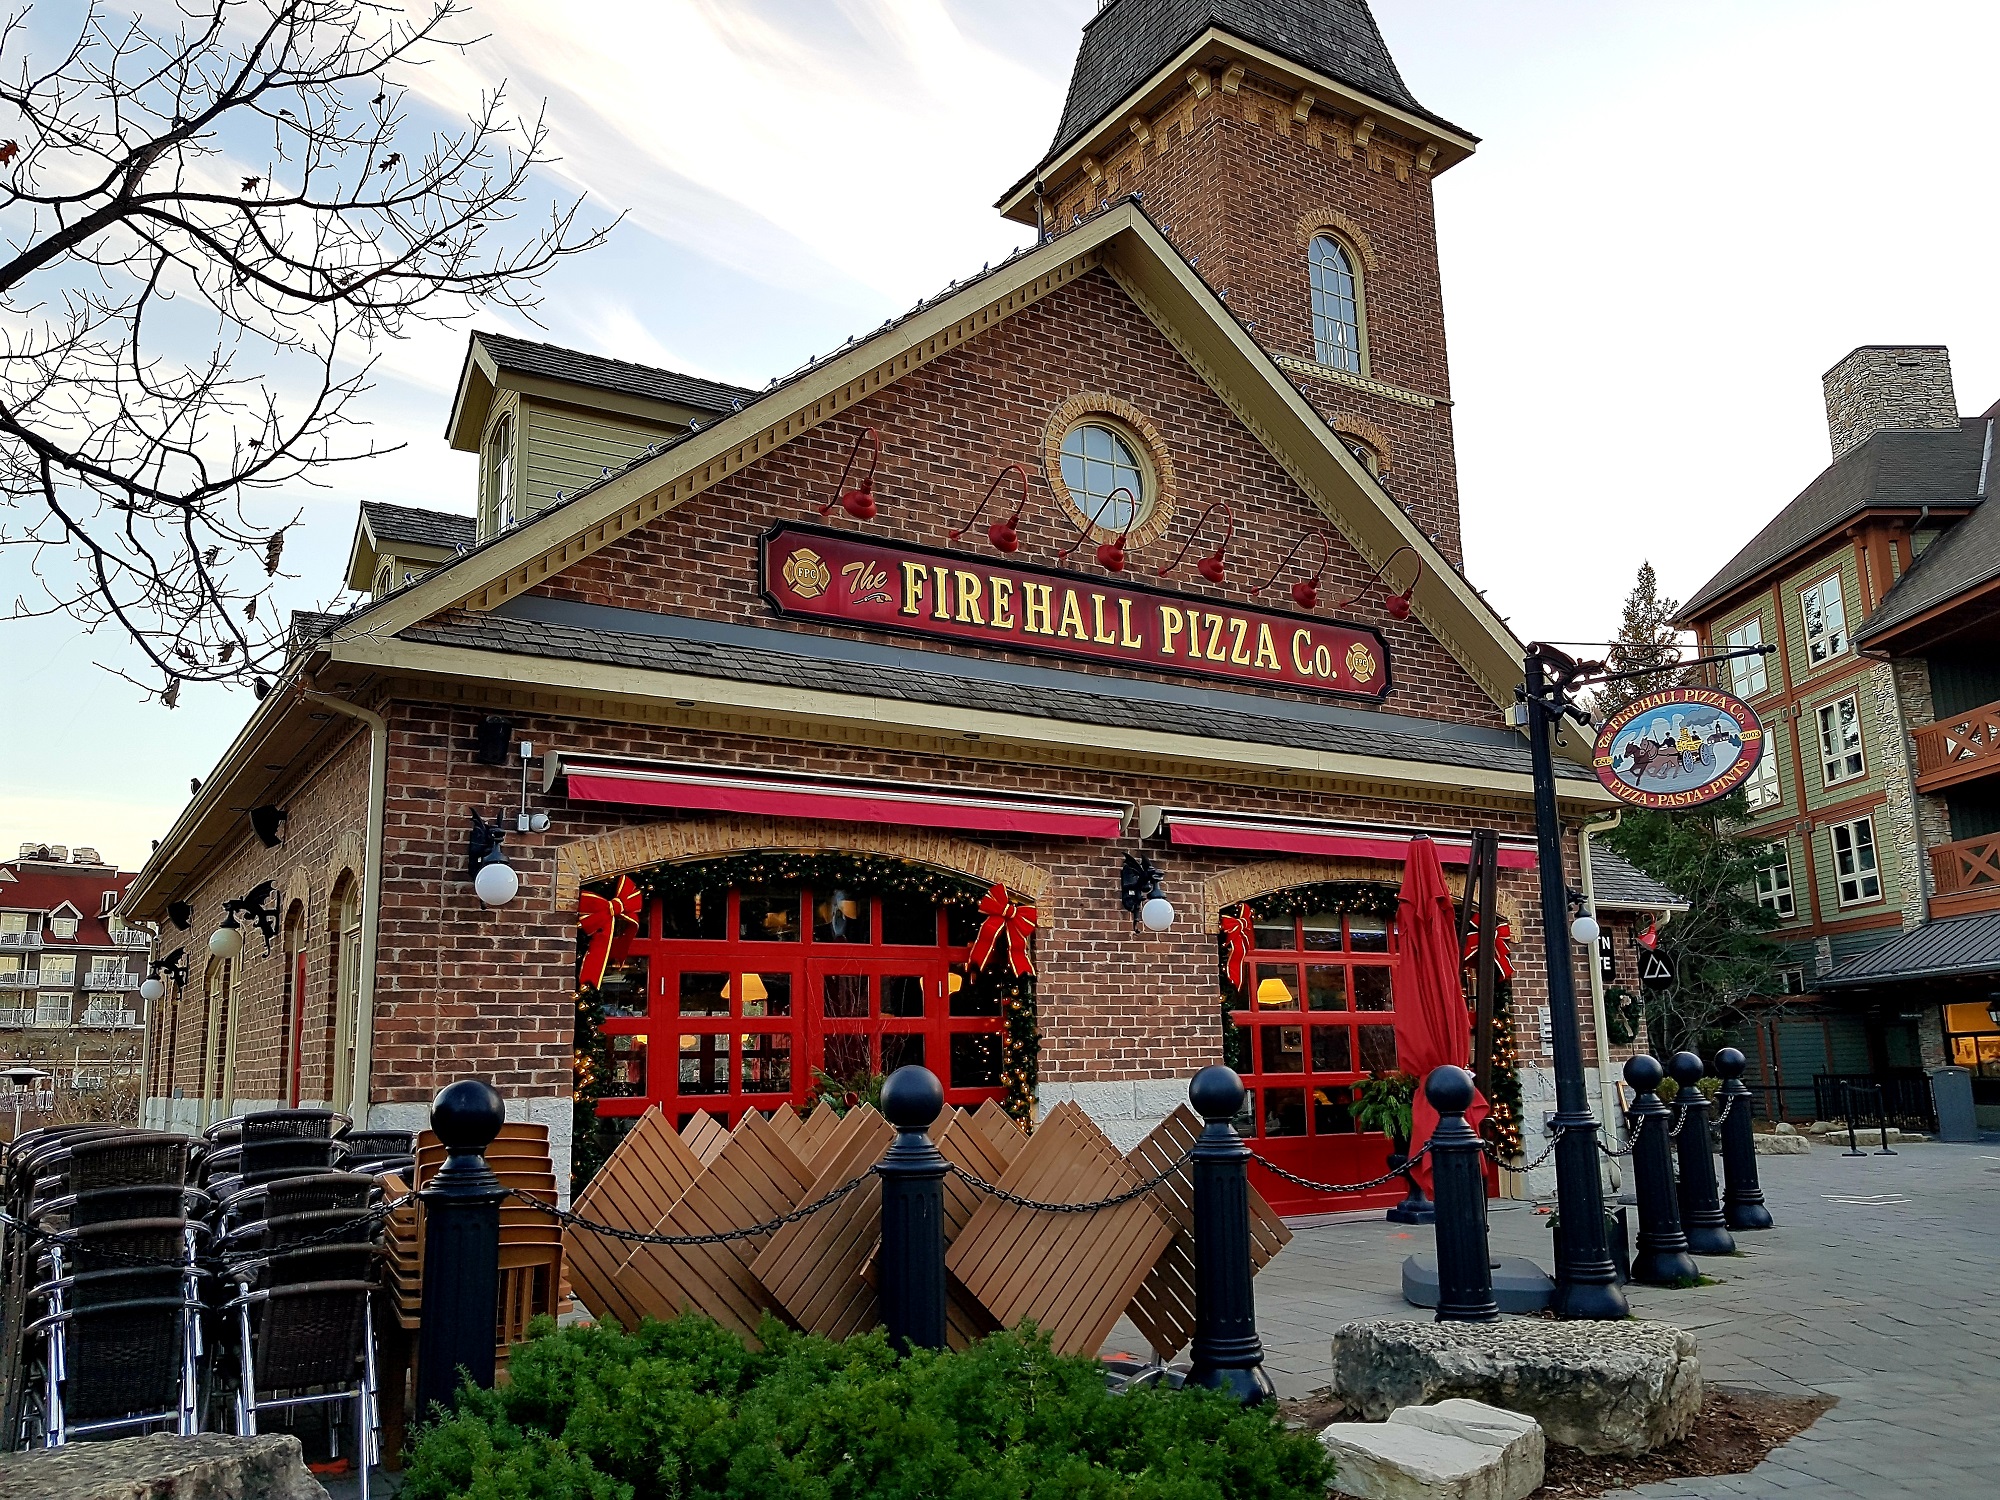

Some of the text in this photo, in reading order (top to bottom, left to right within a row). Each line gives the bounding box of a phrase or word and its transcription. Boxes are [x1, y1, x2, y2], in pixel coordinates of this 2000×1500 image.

[797, 567, 817, 579] FPC
[841, 560, 1338, 679] The FIREHALL PIZZA Co.
[1609, 692, 1680, 731] FIREHALL
[1683, 689, 1727, 709] PIZZA
[1729, 703, 1746, 724] Co.
[1741, 731, 1761, 740] 2003
[1609, 758, 1751, 806] PIZZA PASTA PINTS
